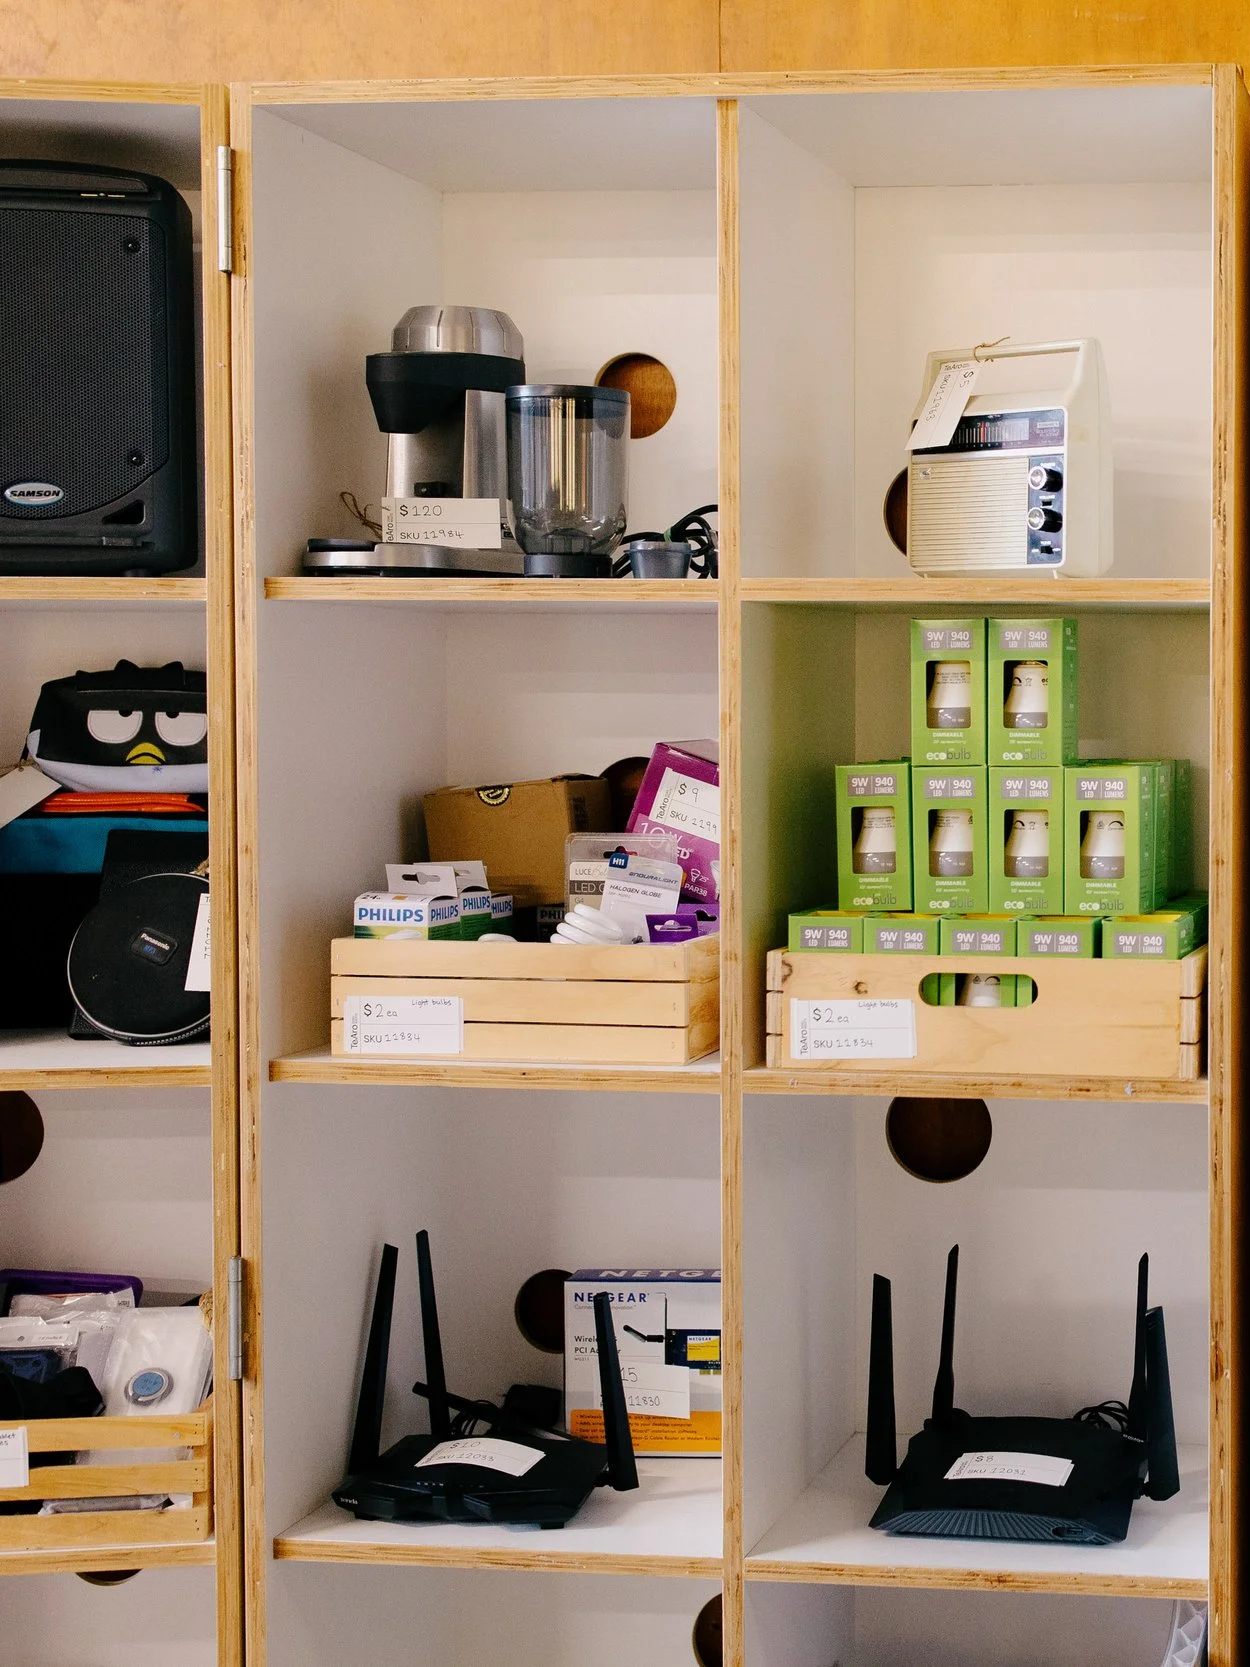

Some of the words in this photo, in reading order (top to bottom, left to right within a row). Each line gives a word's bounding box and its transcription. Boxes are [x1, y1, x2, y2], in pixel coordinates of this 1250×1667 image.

[400, 504, 442, 517] $120
[400, 532, 420, 540] SKU
[423, 529, 464, 539] 11984
[927, 631, 945, 641] 9W
[951, 631, 969, 641] 940
[1004, 631, 1022, 641] 9W
[1028, 631, 1046, 640] 940
[931, 641, 940, 649] LED
[950, 641, 970, 649] LUMENS
[1028, 641, 1048, 649] LUMENS
[851, 777, 869, 787] 9W
[875, 777, 894, 786] 940
[929, 780, 946, 790] 9W
[952, 780, 972, 789] 940
[1005, 780, 1024, 790] 9W
[1029, 779, 1049, 789] 940
[1080, 780, 1098, 790] 9W
[1105, 780, 1124, 790] 940
[678, 782, 699, 803] $9
[875, 786, 894, 794] LUMENS
[1029, 789, 1049, 797] LUMENS
[1085, 790, 1094, 798] LED
[655, 797, 670, 820] TeAro
[669, 810, 687, 822] SKU
[575, 868, 591, 876] LUCE
[574, 882, 596, 893] LED
[609, 884, 640, 894] HALOGEN
[641, 890, 663, 898] GLOBE
[684, 883, 708, 897] PAR38
[462, 896, 491, 910] PHILIPS
[358, 907, 424, 922] PHILIPS
[430, 904, 459, 922] PHILIPS
[804, 929, 822, 939] 9W
[828, 929, 847, 939] 940
[879, 932, 898, 942] 9W
[903, 932, 923, 942] 940
[956, 933, 975, 943] 9W
[981, 933, 1000, 943] 940
[141, 933, 170, 951] Panasonic
[827, 939, 848, 947] LUMENS
[1034, 934, 1052, 944] 9W
[1058, 935, 1077, 945] 940
[1118, 936, 1137, 946] 9W
[1143, 936, 1162, 946] 940
[903, 942, 924, 950] LUMENS
[980, 943, 1001, 951] LUMENS
[1142, 946, 1163, 954] LUMENS
[411, 1000, 429, 1008] Light
[858, 1001, 877, 1010] Light
[363, 1035, 383, 1043] SKU
[385, 1032, 420, 1042] 11834
[800, 1029, 808, 1055] TeAro
[813, 1040, 833, 1048] SKU
[836, 1038, 873, 1048] 11834
[574, 1292, 647, 1303] NEGEAR
[574, 1346, 588, 1354] PCI
[621, 1367, 638, 1383] 15
[628, 1395, 661, 1407] 11830
